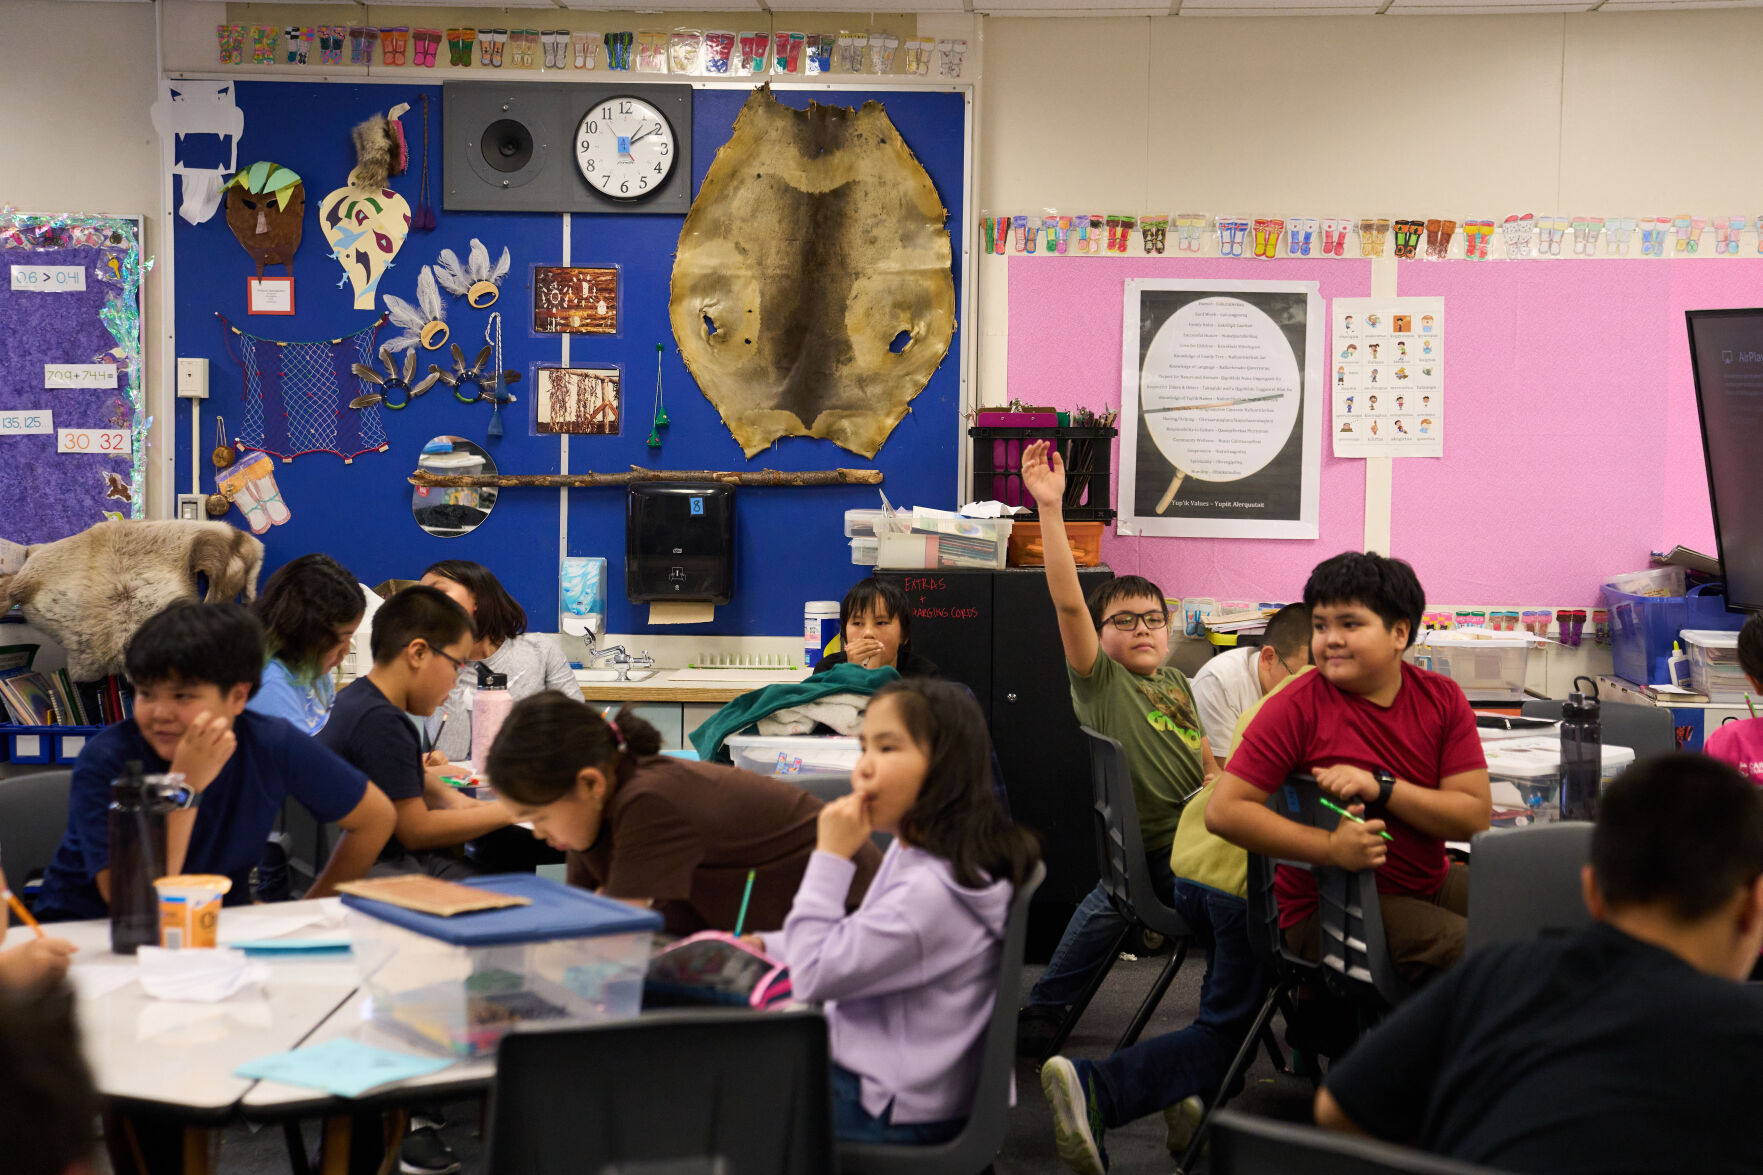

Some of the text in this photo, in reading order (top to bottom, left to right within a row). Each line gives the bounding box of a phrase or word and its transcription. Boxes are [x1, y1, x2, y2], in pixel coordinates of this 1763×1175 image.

[601, 107, 612, 120] 11
[619, 101, 633, 114] 12
[585, 121, 598, 134] 10
[654, 123, 663, 135] 2
[580, 140, 590, 153] 9
[660, 143, 669, 155] 3
[586, 159, 595, 172] 8
[653, 162, 663, 174] 4
[602, 175, 611, 188] 7
[620, 180, 629, 193] 6
[639, 176, 648, 189] 5
[64, 433, 124, 450] 30 32
[693, 499, 701, 513] 8
[904, 576, 947, 592] EXTRAS
[911, 606, 979, 619] HARGING CORDS
